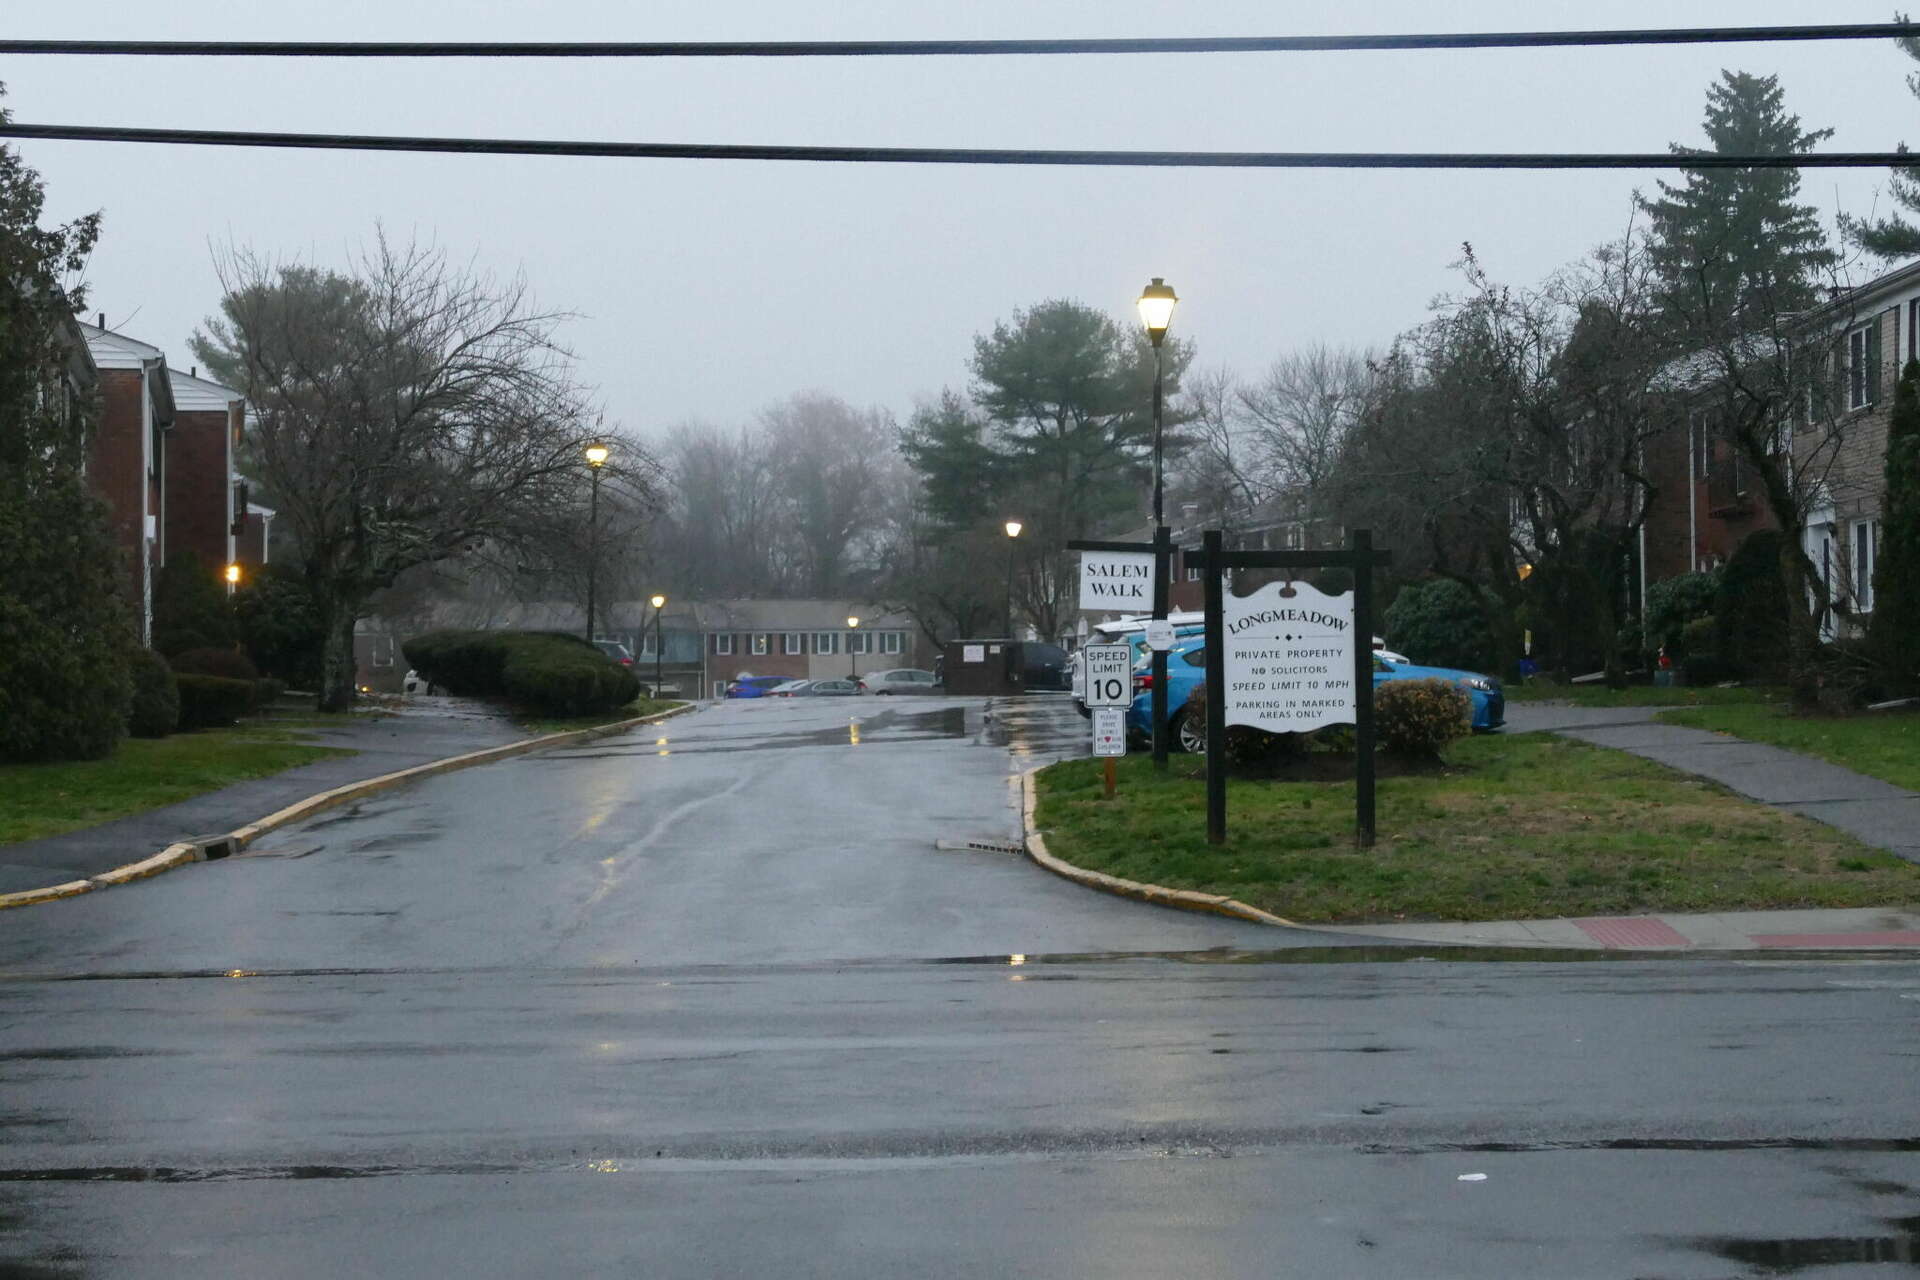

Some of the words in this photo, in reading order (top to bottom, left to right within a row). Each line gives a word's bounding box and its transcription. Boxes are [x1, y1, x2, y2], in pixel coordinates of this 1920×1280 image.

[1087, 563, 1148, 578] SALEM
[1091, 582, 1144, 597] WALK
[1228, 609, 1349, 635] LONGMEADOW
[1089, 651, 1128, 661] SPEED
[1235, 650, 1281, 659] PRIVATE
[1287, 648, 1343, 658] PROPERTY
[1092, 663, 1123, 673] LIMIT
[1251, 667, 1266, 675] NO
[1271, 665, 1328, 675] SOLICITORS
[1094, 679, 1123, 700] 10
[1232, 681, 1266, 691] SPEED
[1271, 681, 1302, 690] LIMIT
[1307, 680, 1319, 690] 10
[1325, 680, 1349, 689] MPH
[1236, 700, 1280, 709] PARKING
[1285, 700, 1296, 708] IN
[1302, 699, 1345, 708] MARKED
[1259, 711, 1291, 719] AREAS
[1295, 710, 1323, 719] ONLY
